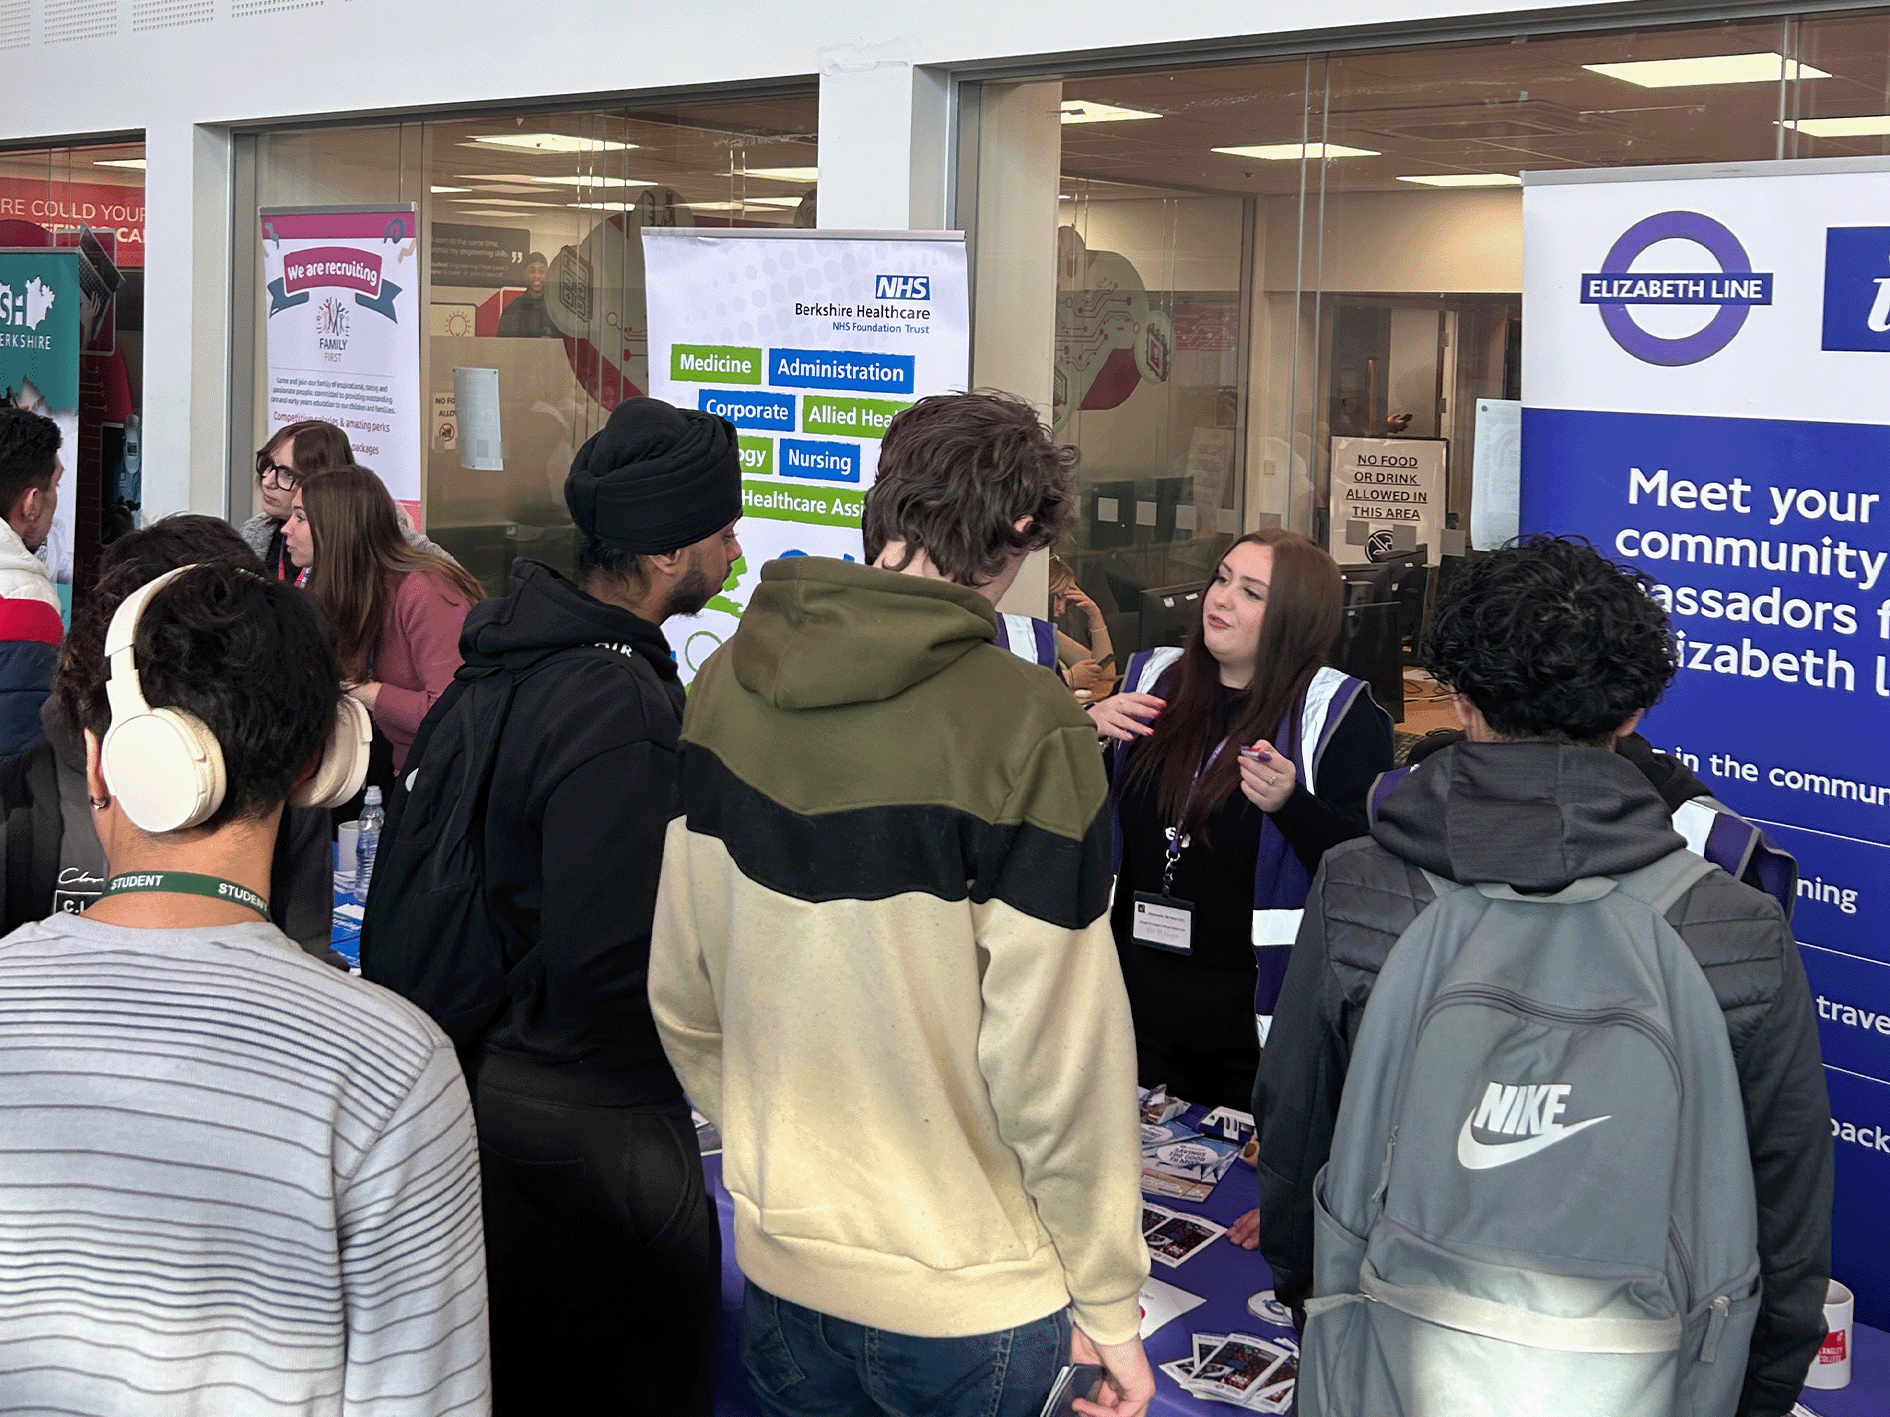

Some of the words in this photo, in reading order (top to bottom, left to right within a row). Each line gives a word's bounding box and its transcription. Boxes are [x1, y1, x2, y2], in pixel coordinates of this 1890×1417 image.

[31, 200, 96, 219] COULD
[116, 226, 145, 243] CA
[287, 264, 304, 280] We
[306, 262, 324, 277] are
[325, 260, 378, 286] recruiting
[876, 278, 928, 299] NHS
[1589, 279, 1705, 298] ELIZABETH
[1711, 279, 1763, 298] LINE
[795, 302, 853, 317] Berkshire
[856, 304, 930, 320] Healthcare
[832, 321, 850, 332] NHS
[852, 322, 901, 333] Foundation
[905, 324, 930, 334] Trust
[319, 338, 348, 351] FAMILY
[324, 352, 342, 362] FIRST
[680, 353, 752, 374] Medicine
[777, 358, 904, 383] Administration
[298, 378, 307, 387] join
[317, 380, 331, 389] family
[380, 385, 388, 393] and
[288, 398, 300, 406] early
[312, 400, 335, 408] education
[349, 403, 366, 411] children
[367, 404, 375, 412] and
[345, 393, 365, 402] providing
[365, 395, 393, 405] outstanding
[706, 398, 789, 422] Corporate
[808, 405, 857, 425] Allied
[340, 418, 346, 427] &
[345, 419, 371, 431] amazing
[372, 422, 391, 433] perks
[352, 443, 380, 456] packages
[788, 449, 852, 475] Nursing
[1357, 454, 1377, 465] NO
[1381, 455, 1418, 467] FOOD
[1354, 471, 1373, 482] OR
[1376, 472, 1418, 484] DRINK
[742, 489, 827, 514] Healthcare
[1346, 488, 1410, 501] ALLOWED
[1413, 491, 1427, 502] IN
[1628, 467, 1751, 513] Meet
[1769, 486, 1880, 526] your
[1352, 506, 1382, 517] THIS
[1386, 508, 1420, 519] AREA
[1615, 528, 1888, 590] community
[1637, 582, 1858, 635] assadors
[1709, 754, 1759, 782] the
[110, 875, 164, 890] STUDENT
[218, 883, 268, 912] STUDENT
[1796, 876, 1859, 915] ning
[1816, 995, 1890, 1036] trave
[1473, 1081, 1572, 1135] NIKE
